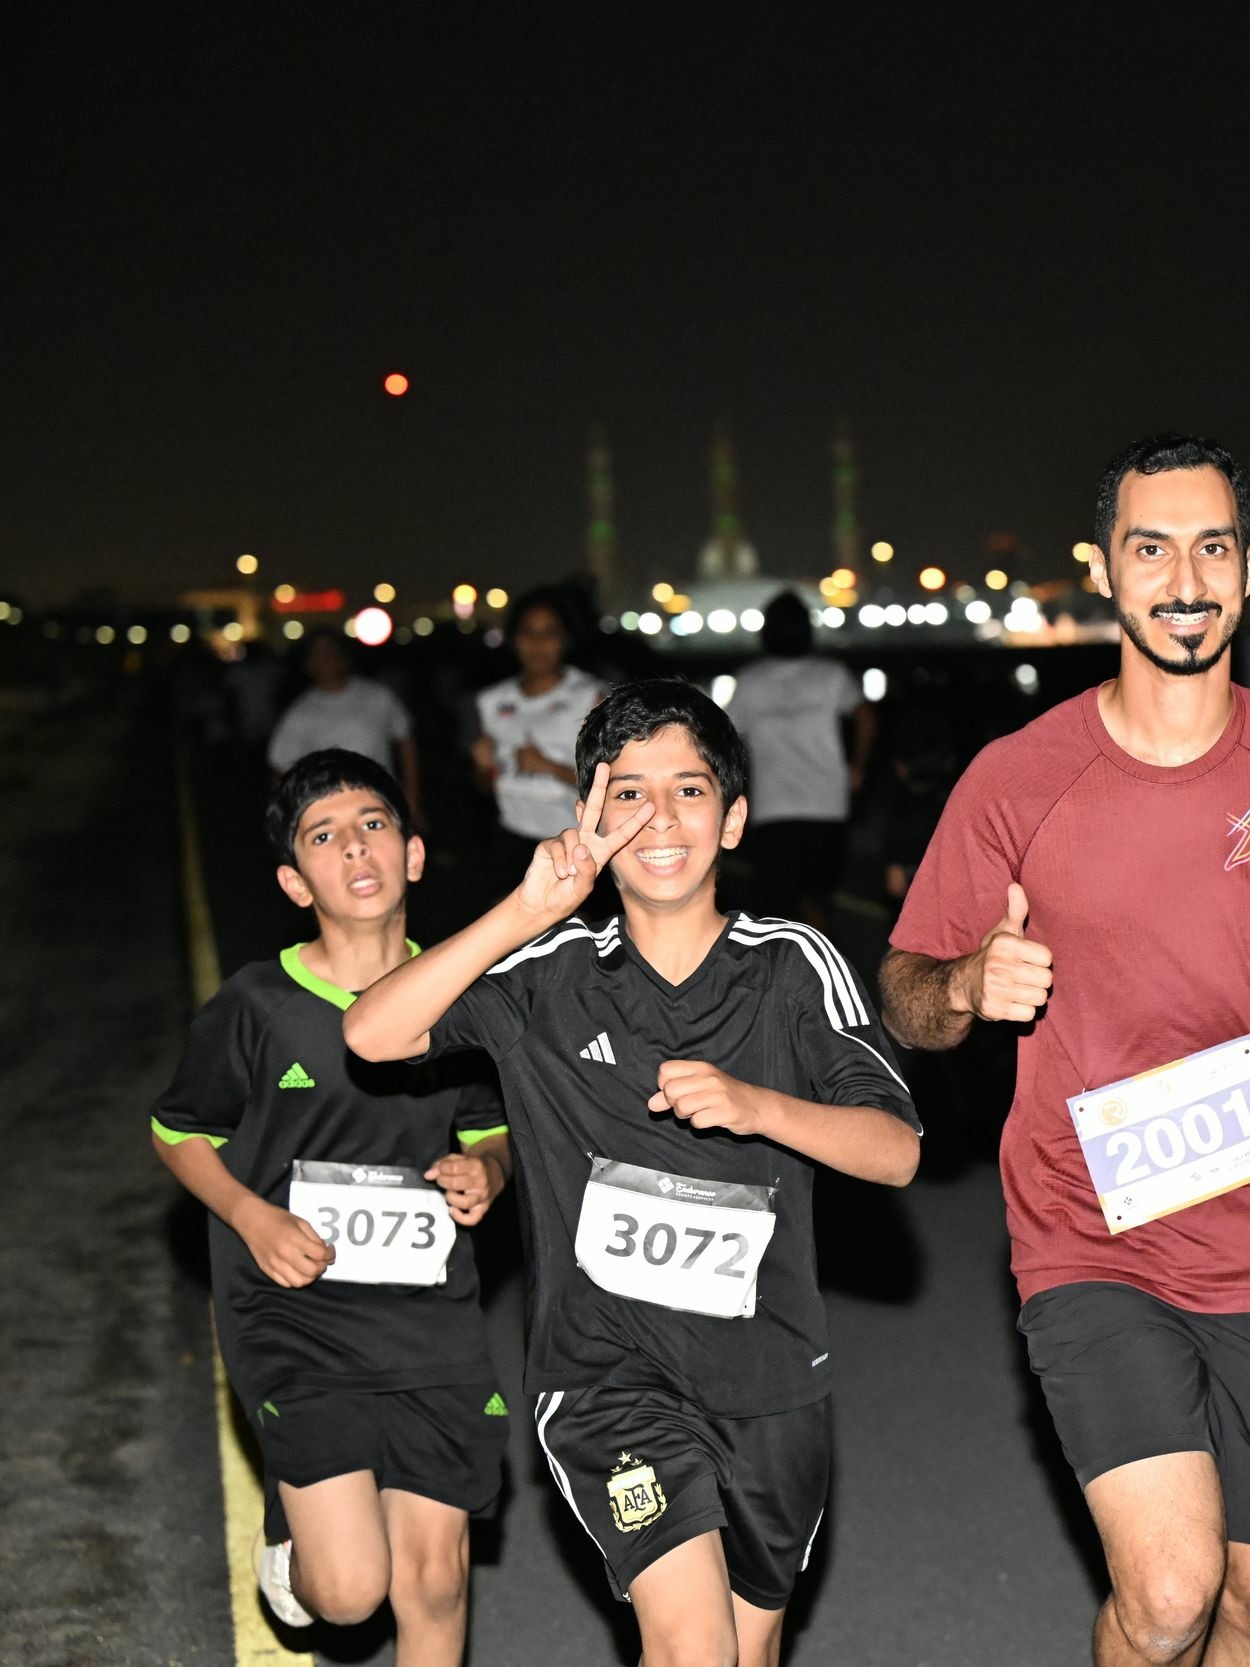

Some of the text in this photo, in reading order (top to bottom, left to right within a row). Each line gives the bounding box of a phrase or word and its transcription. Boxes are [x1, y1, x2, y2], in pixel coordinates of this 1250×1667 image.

[317, 1206, 436, 1249] 3073
[605, 1213, 749, 1279] 3072
[624, 1483, 652, 1512] AFA
